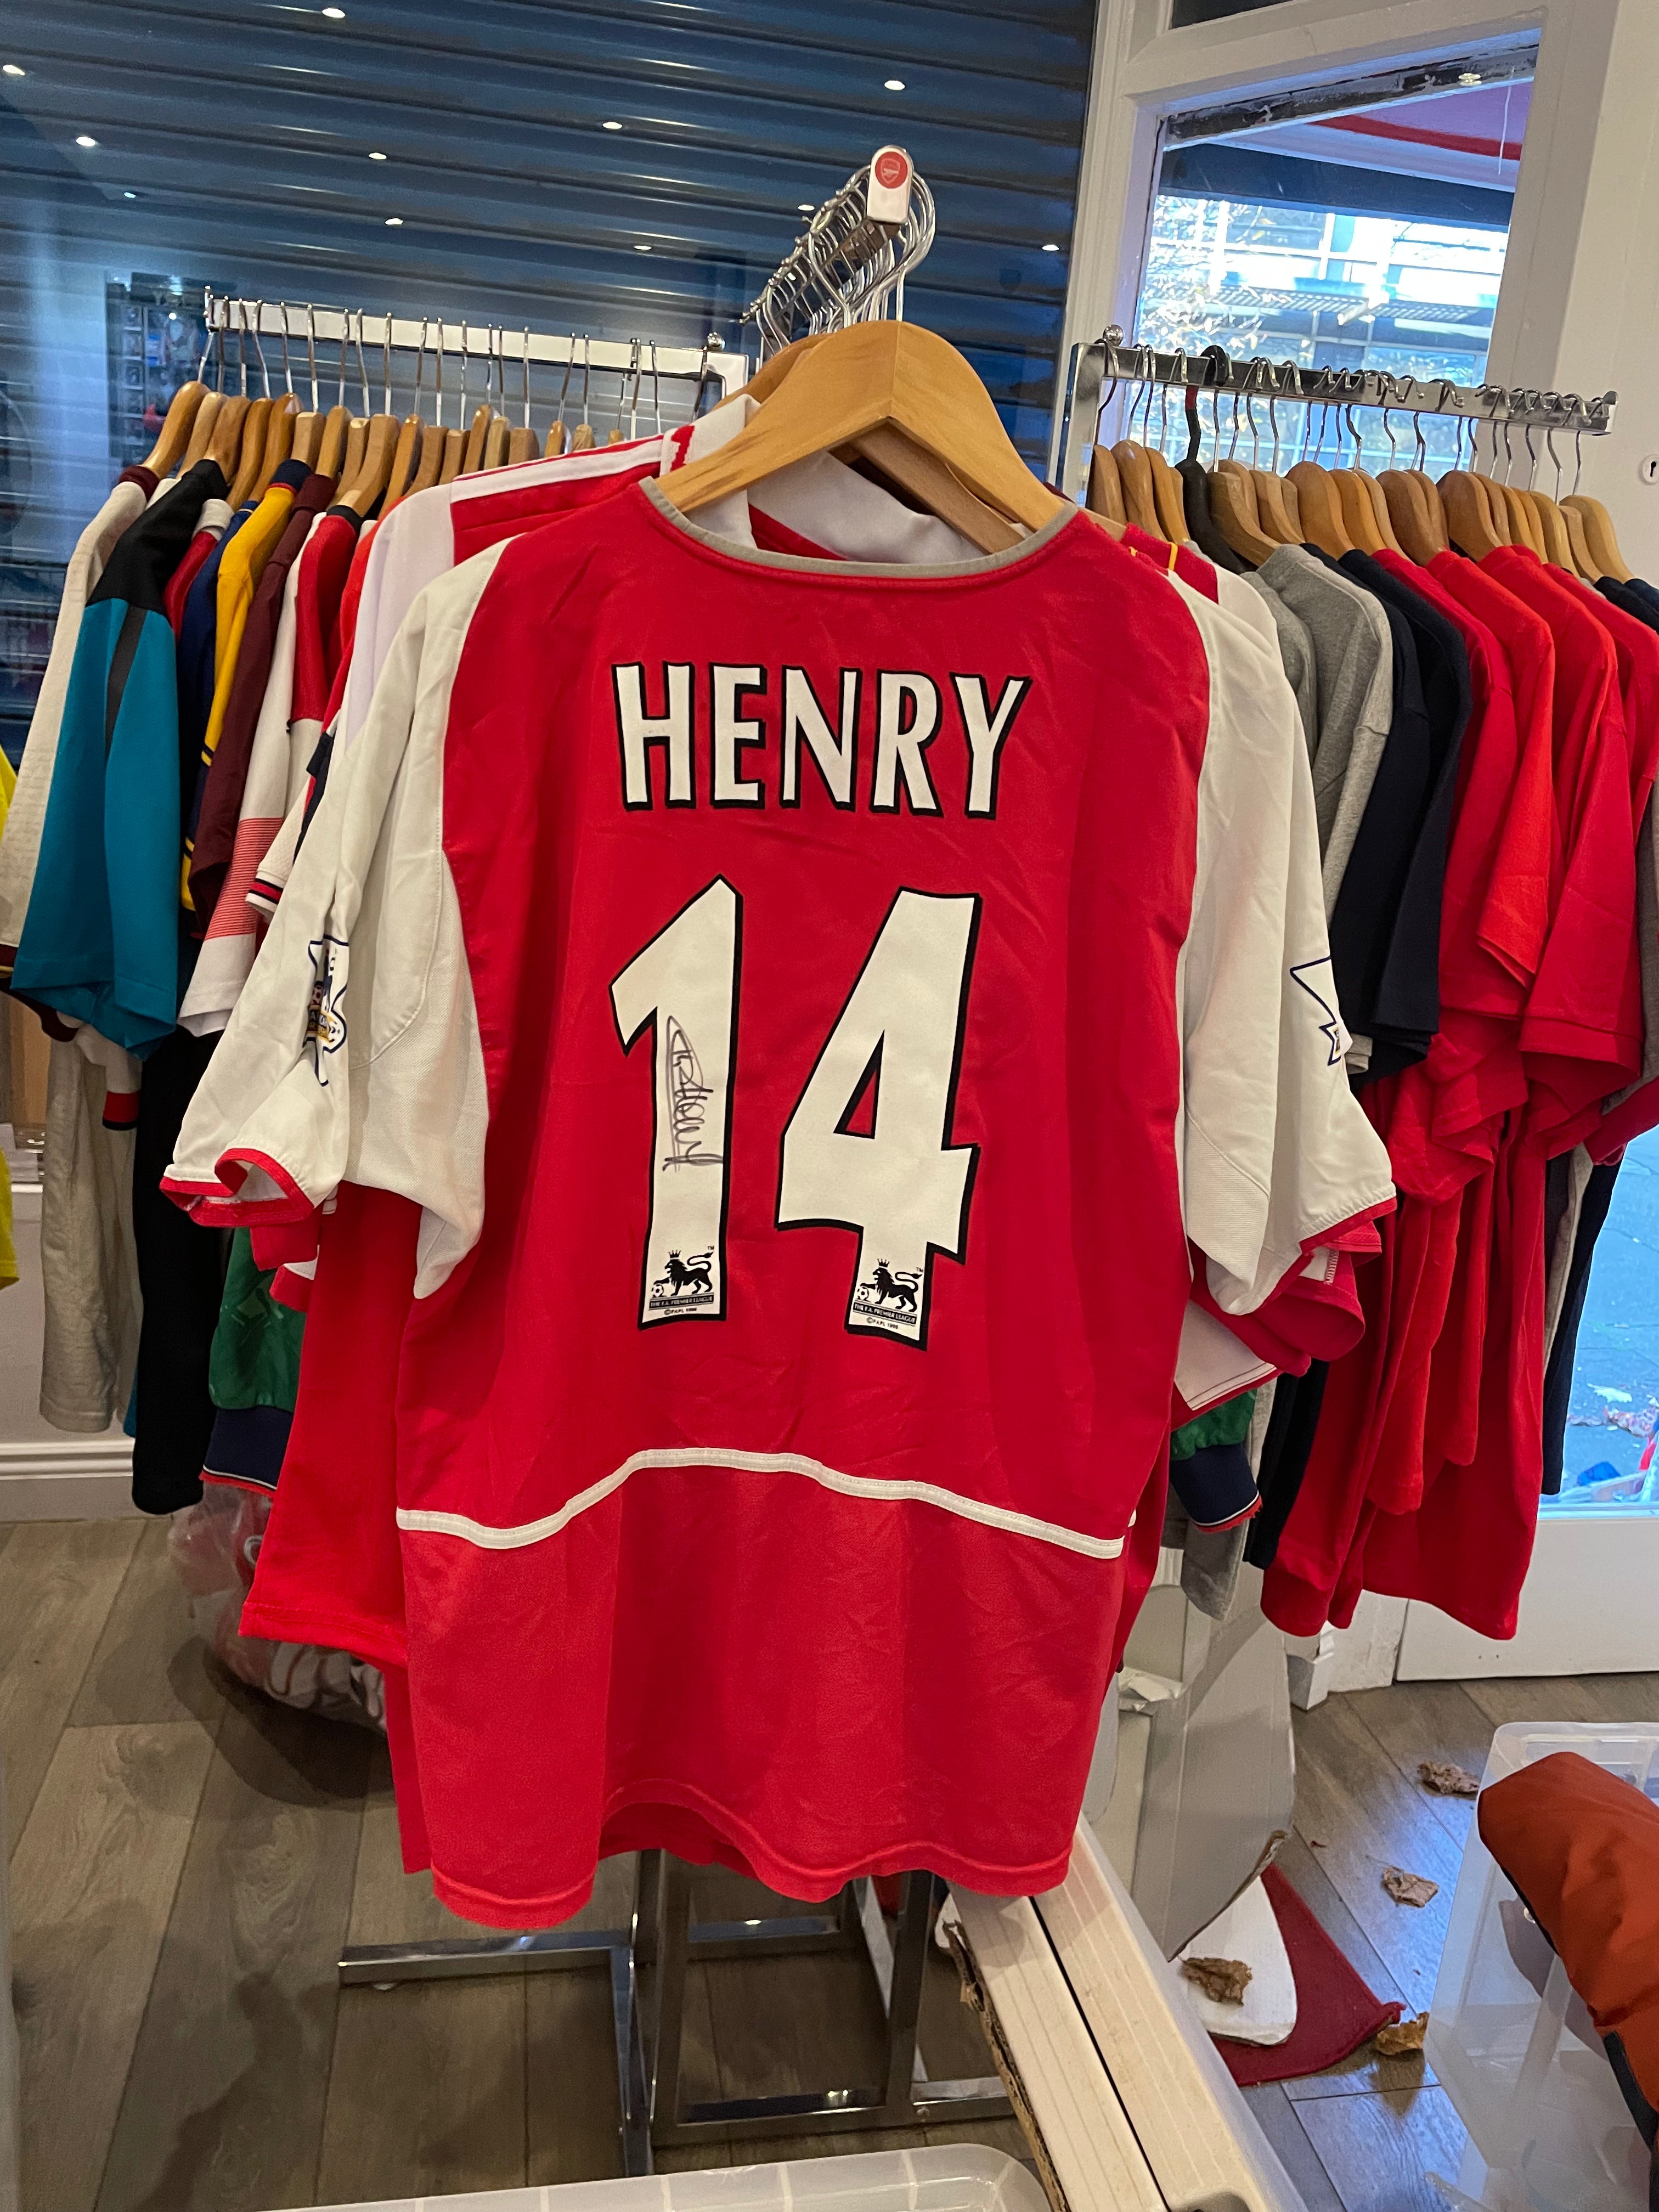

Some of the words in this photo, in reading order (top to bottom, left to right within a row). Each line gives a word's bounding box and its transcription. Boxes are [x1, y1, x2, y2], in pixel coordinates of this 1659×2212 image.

[612, 662, 1031, 820] HENRY
[610, 874, 981, 1350] 14
[873, 1308, 895, 1318] PREMIER
[895, 1313, 916, 1323] LEAGUE
